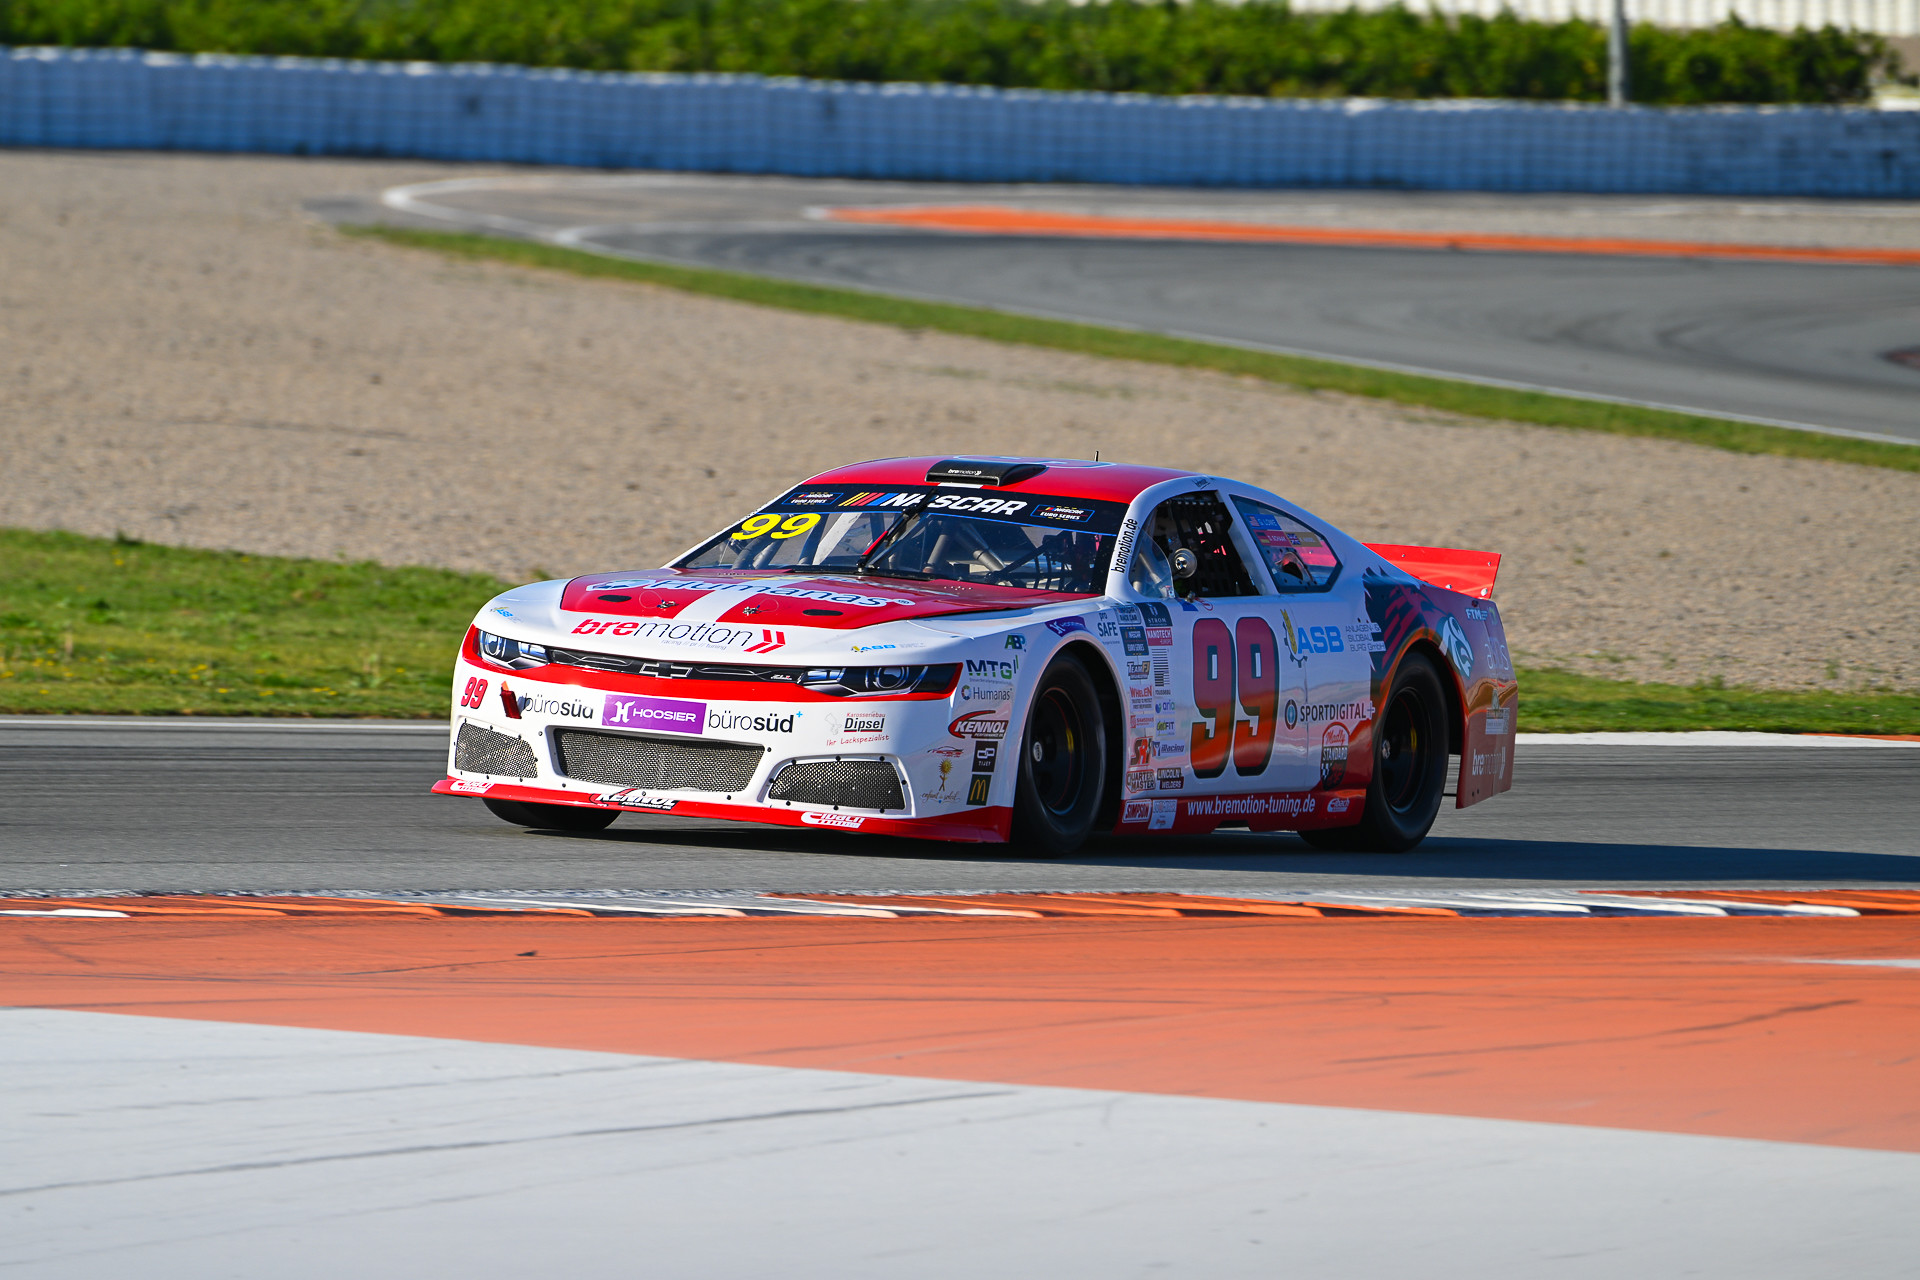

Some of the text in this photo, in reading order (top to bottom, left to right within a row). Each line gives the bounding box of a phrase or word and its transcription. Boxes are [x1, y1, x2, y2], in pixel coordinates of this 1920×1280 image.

[880, 493, 1028, 515] NASCAR
[731, 513, 821, 540] 99
[1111, 518, 1138, 574] bremotion.de
[651, 579, 884, 606] Humanas
[1099, 612, 1108, 621] pro
[571, 618, 753, 647] bremotion
[1098, 622, 1118, 637] SAFE
[1146, 630, 1171, 639] NANOTECH
[1298, 626, 1344, 654] ASB
[966, 660, 1012, 679] MTG
[461, 677, 488, 709] 99
[973, 687, 1010, 700] Humanas
[1190, 617, 1279, 779] 99
[632, 708, 697, 723] HOOSIER
[844, 718, 885, 732] Dipsel
[954, 720, 1006, 733] KENNOL
[841, 734, 890, 744] Lackspezialist
[1161, 743, 1185, 753] iRacing
[1323, 747, 1348, 761] STANDARD
[1127, 771, 1154, 785] QUARTER
[1158, 768, 1181, 779] LINCOLN
[1132, 781, 1154, 791] MASTER
[1126, 803, 1149, 819] SIMPSON
[1188, 793, 1316, 818] www.bremotion-tuning.de
